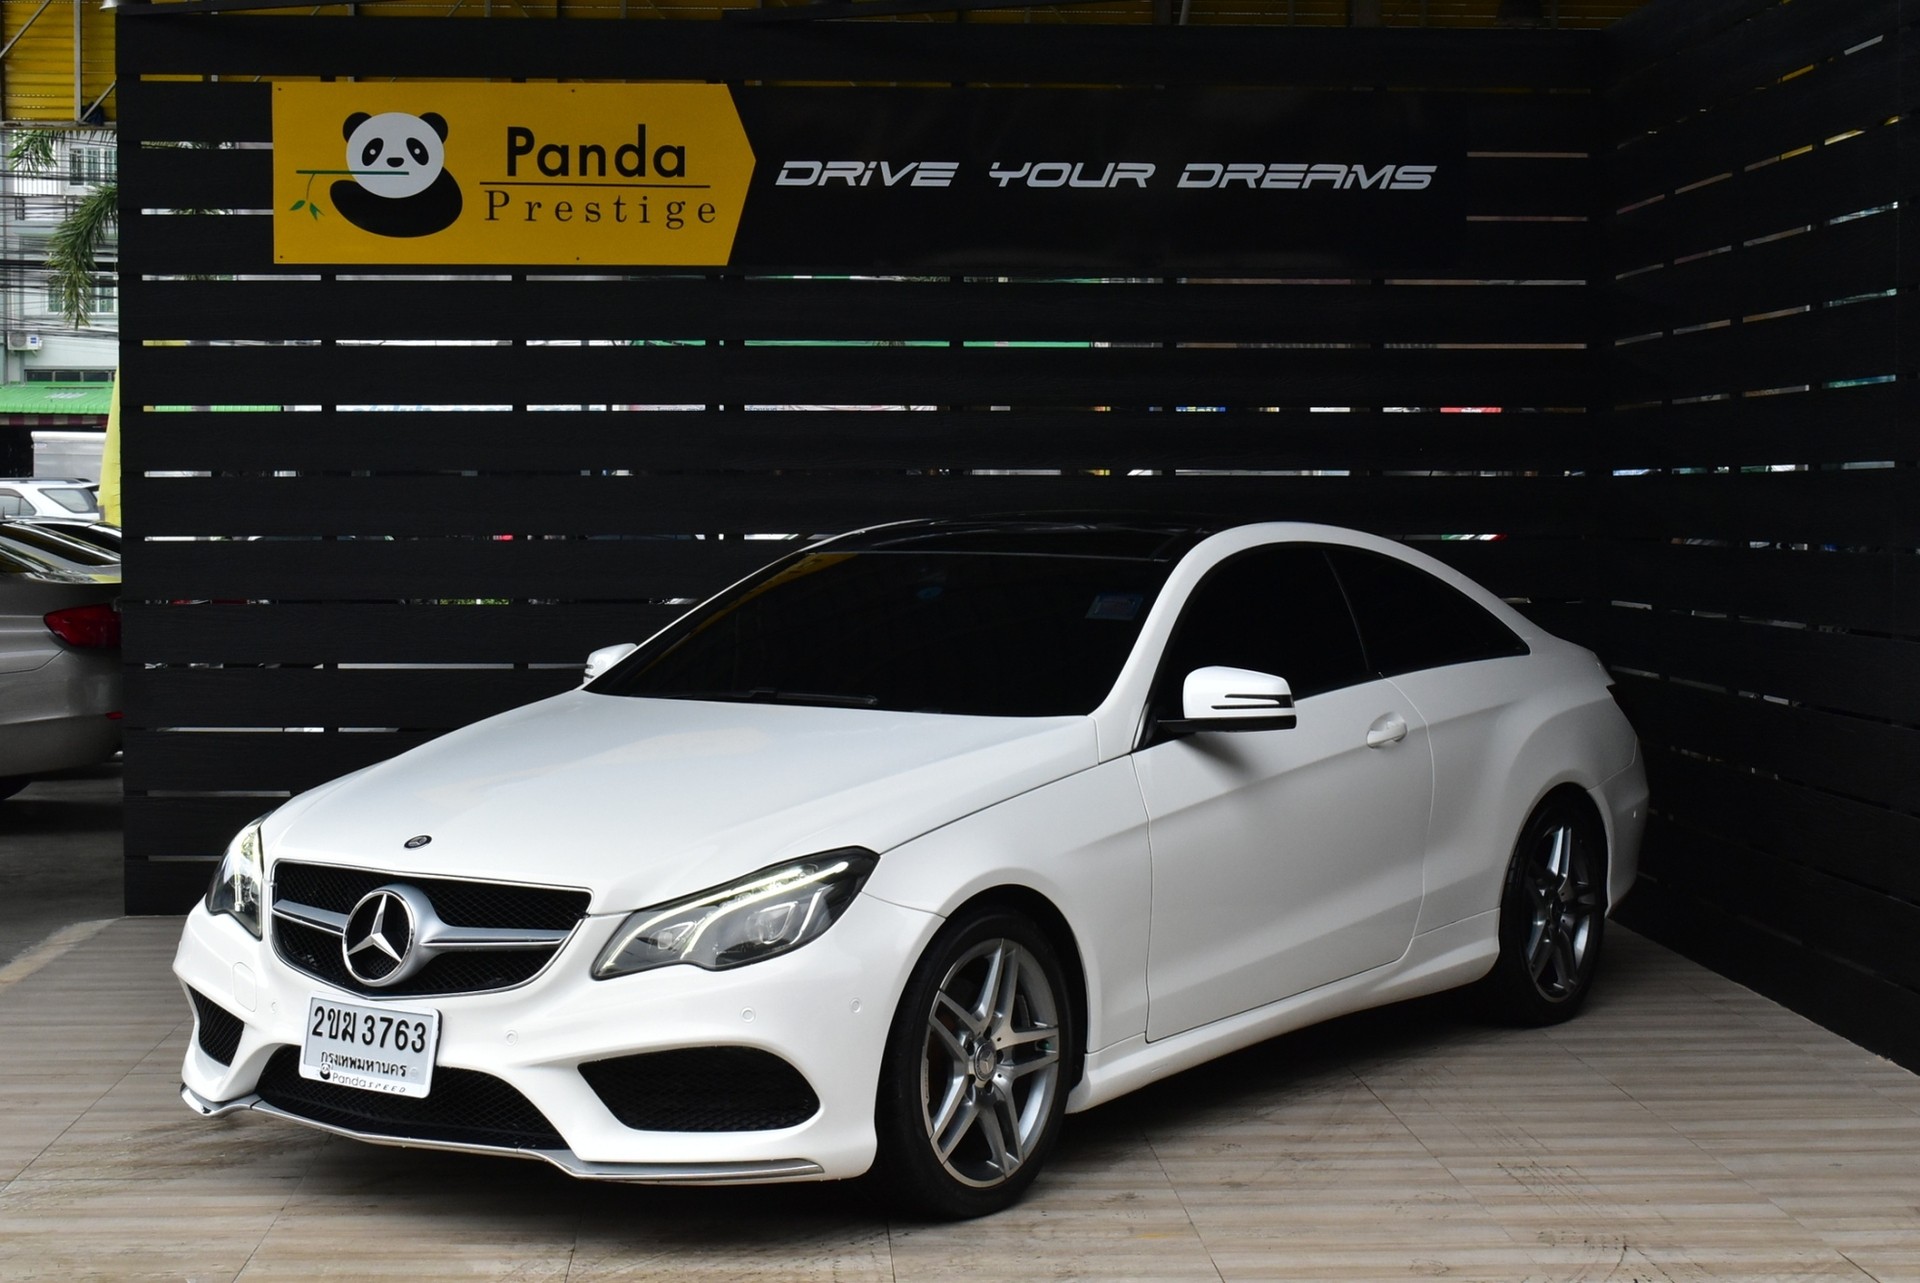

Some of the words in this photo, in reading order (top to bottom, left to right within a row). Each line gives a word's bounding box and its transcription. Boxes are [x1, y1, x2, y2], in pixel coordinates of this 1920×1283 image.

[507, 123, 686, 178] Panda
[989, 161, 1156, 188] YOUR
[1177, 163, 1437, 191] DREAMS
[484, 189, 716, 231] Prestige
[363, 1015, 426, 1053] 3763
[332, 1072, 367, 1088] Panda
